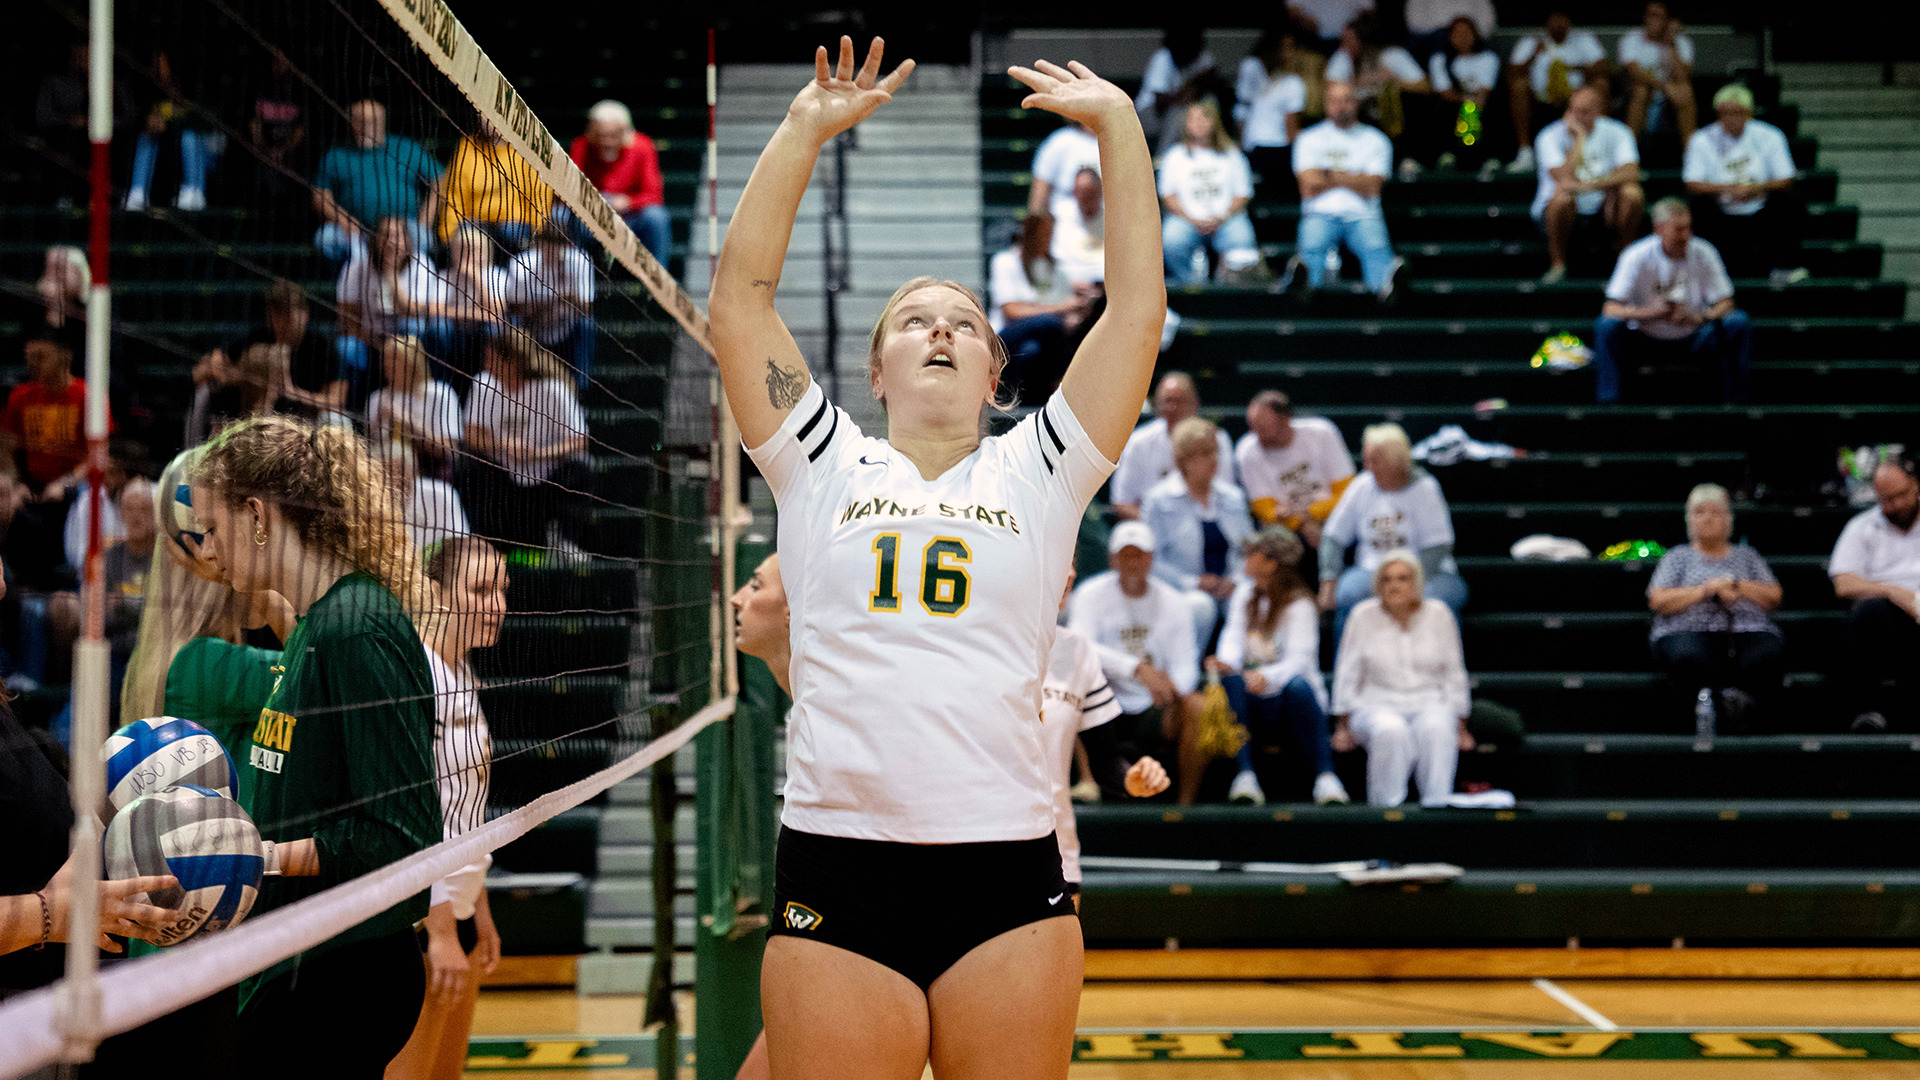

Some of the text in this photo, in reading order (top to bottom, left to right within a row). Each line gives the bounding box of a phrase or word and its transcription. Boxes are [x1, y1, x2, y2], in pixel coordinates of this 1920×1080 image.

[840, 497, 1021, 535] WAYNE STATE
[868, 532, 973, 619] 16
[154, 906, 208, 945] lten
